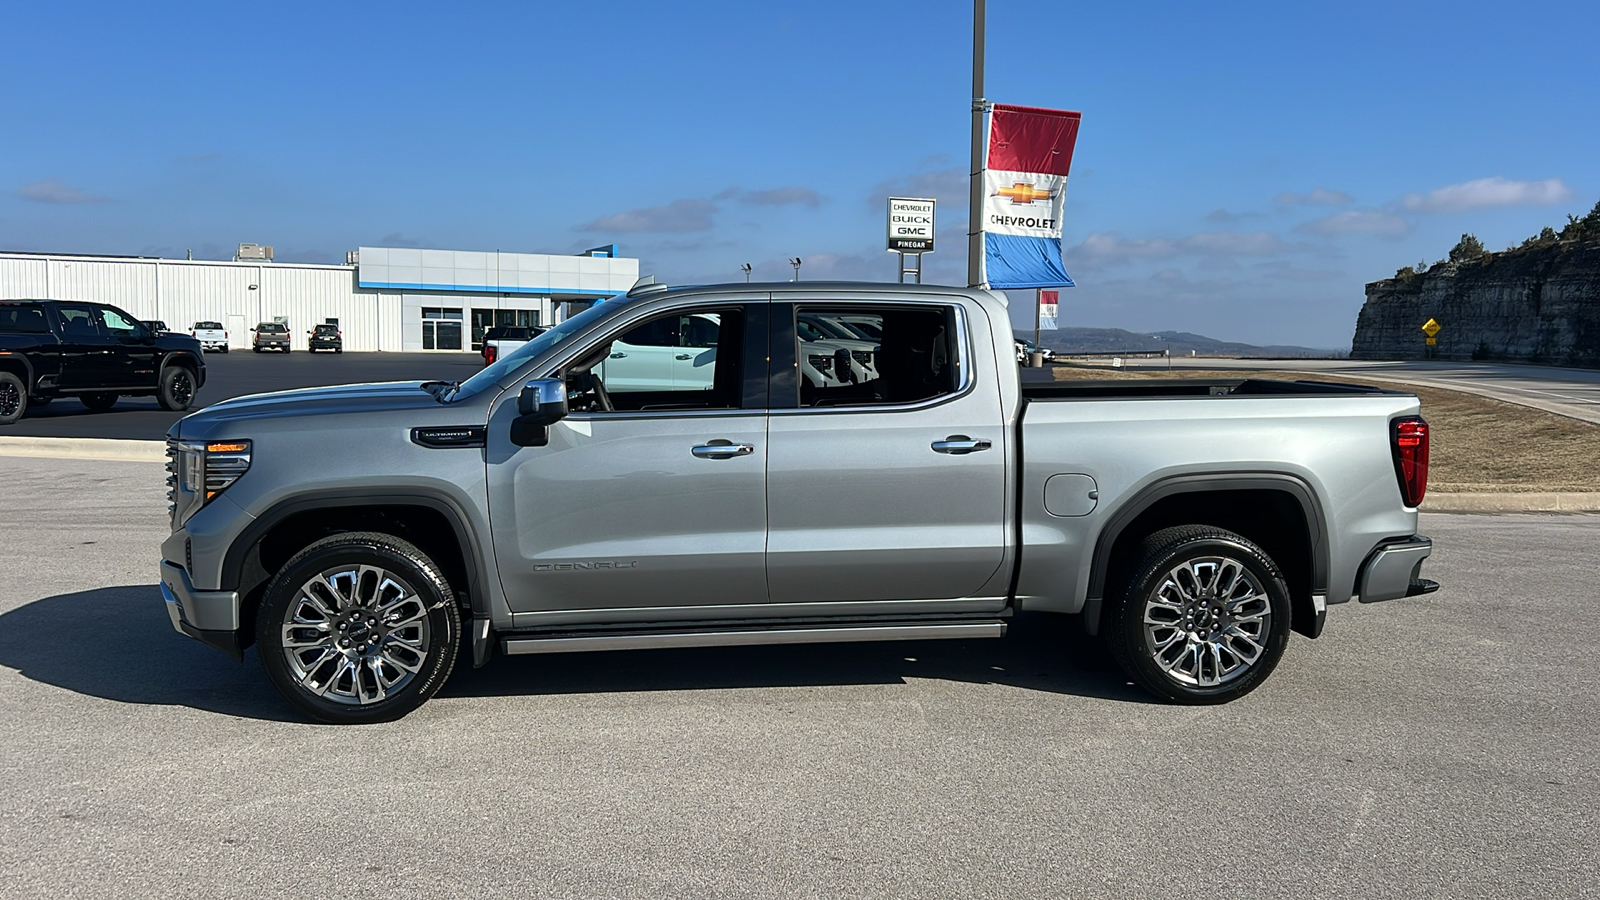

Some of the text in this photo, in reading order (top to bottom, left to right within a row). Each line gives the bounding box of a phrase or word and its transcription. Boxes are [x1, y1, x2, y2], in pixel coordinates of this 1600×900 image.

[893, 204, 931, 212] CHEVROLET
[892, 215, 931, 224] BUICK
[990, 214, 1056, 230] CHEVROLET
[897, 227, 926, 235] GMC
[897, 240, 926, 248] PINEGAR
[533, 560, 637, 572] DENALI
